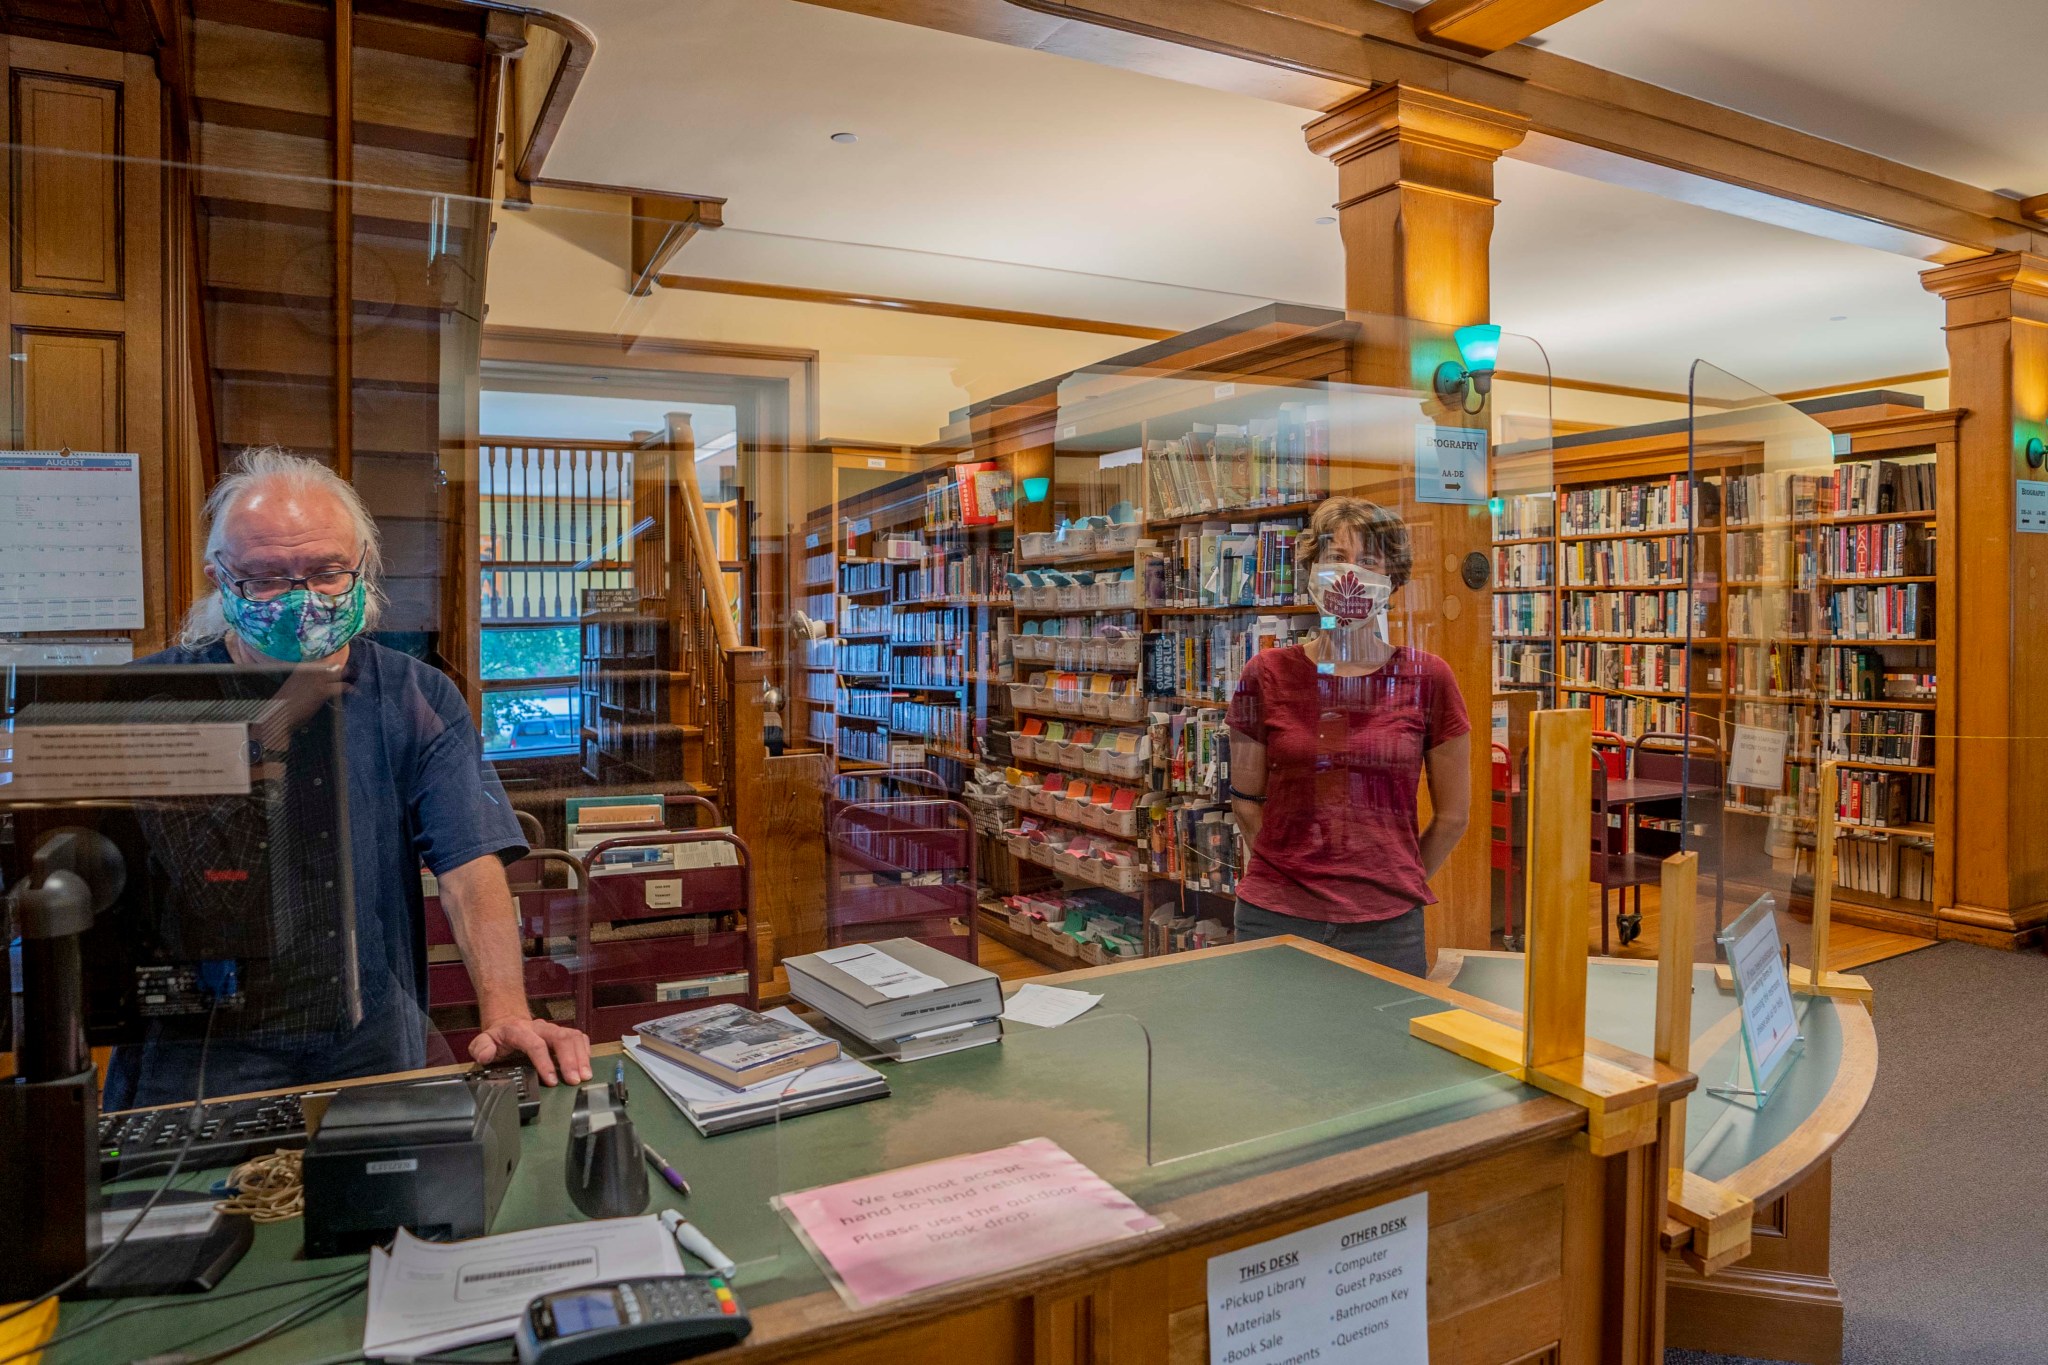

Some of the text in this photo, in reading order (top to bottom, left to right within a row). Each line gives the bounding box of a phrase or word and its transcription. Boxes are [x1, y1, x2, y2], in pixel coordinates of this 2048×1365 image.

[1426, 436, 1479, 451] BIOGRAPHY
[1441, 469, 1465, 478] AA-DE
[1856, 528, 1868, 573] KATE
[1155, 638, 1164, 690] GUINNESS
[1163, 638, 1173, 690] WORLD
[839, 1168, 1057, 1227] hand-to-hand returns.
[852, 1161, 1025, 1208] We cannot accept
[852, 1182, 1080, 1246] Please use the outdoor
[926, 1209, 1036, 1243] book drop.
[1340, 1215, 1408, 1248] OTHER DESK
[1239, 1251, 1300, 1281] THIS DESK
[1334, 1249, 1389, 1275] Computer
[1224, 1275, 1307, 1311] Pickup Library
[1335, 1265, 1404, 1297] Guest Passes
[1336, 1286, 1410, 1322] Bathroom Key
[1226, 1308, 1282, 1338] Materials
[1336, 1318, 1390, 1347] Questions
[1227, 1334, 1284, 1364] Book Sale
[1265, 1347, 1321, 1365] ments
